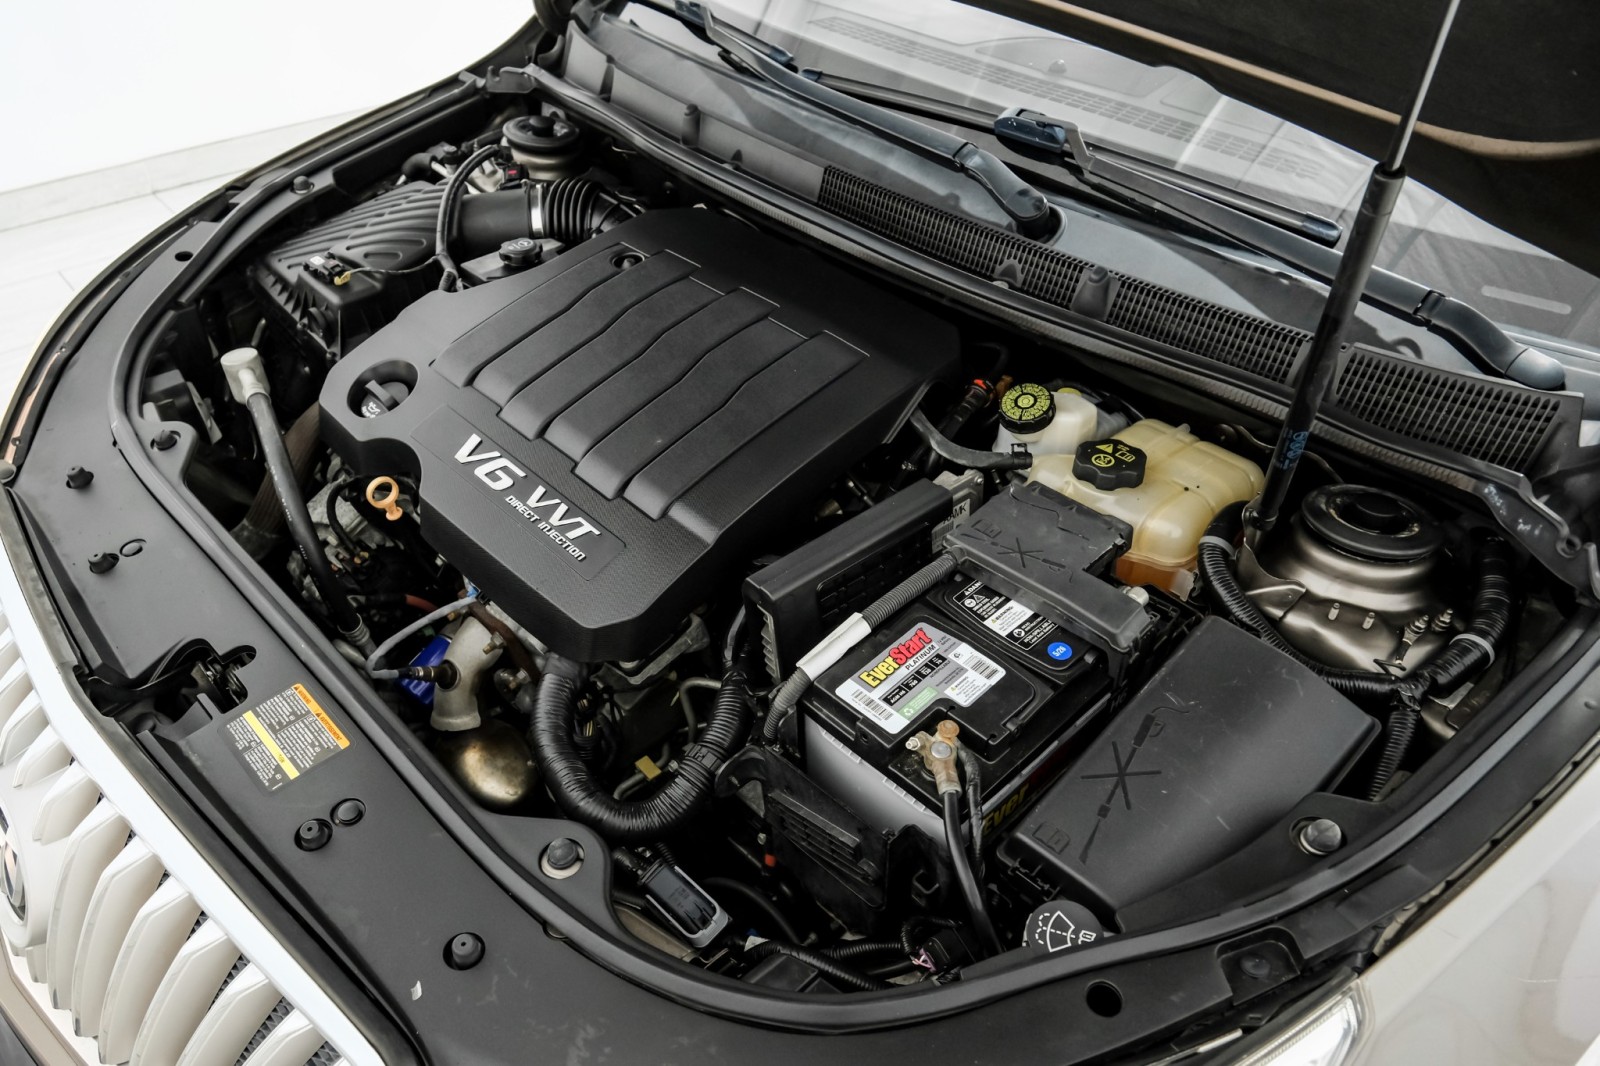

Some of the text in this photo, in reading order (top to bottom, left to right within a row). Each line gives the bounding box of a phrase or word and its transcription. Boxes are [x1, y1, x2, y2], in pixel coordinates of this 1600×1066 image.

[454, 433, 601, 540] V6 VVT
[505, 495, 586, 561] DIRECT INJECTION
[858, 629, 933, 688] EverStart
[905, 644, 936, 670] PLATINUM
